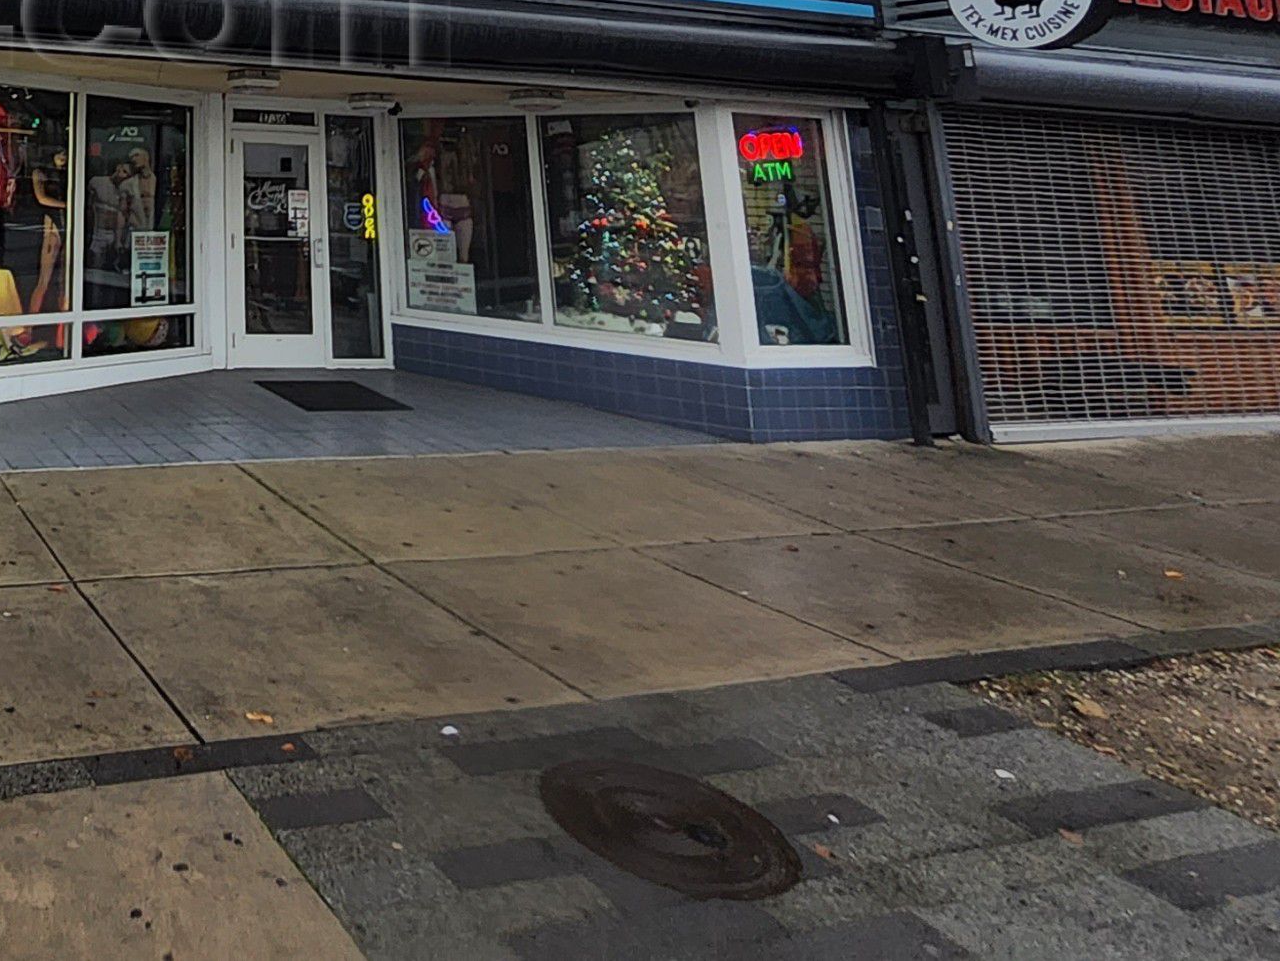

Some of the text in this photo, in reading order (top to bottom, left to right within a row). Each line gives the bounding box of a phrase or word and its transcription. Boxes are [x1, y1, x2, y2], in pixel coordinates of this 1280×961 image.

[960, 0, 1081, 41] TEX-MEX CUISINE
[739, 132, 803, 160] OPEN
[752, 161, 792, 182] ATM
